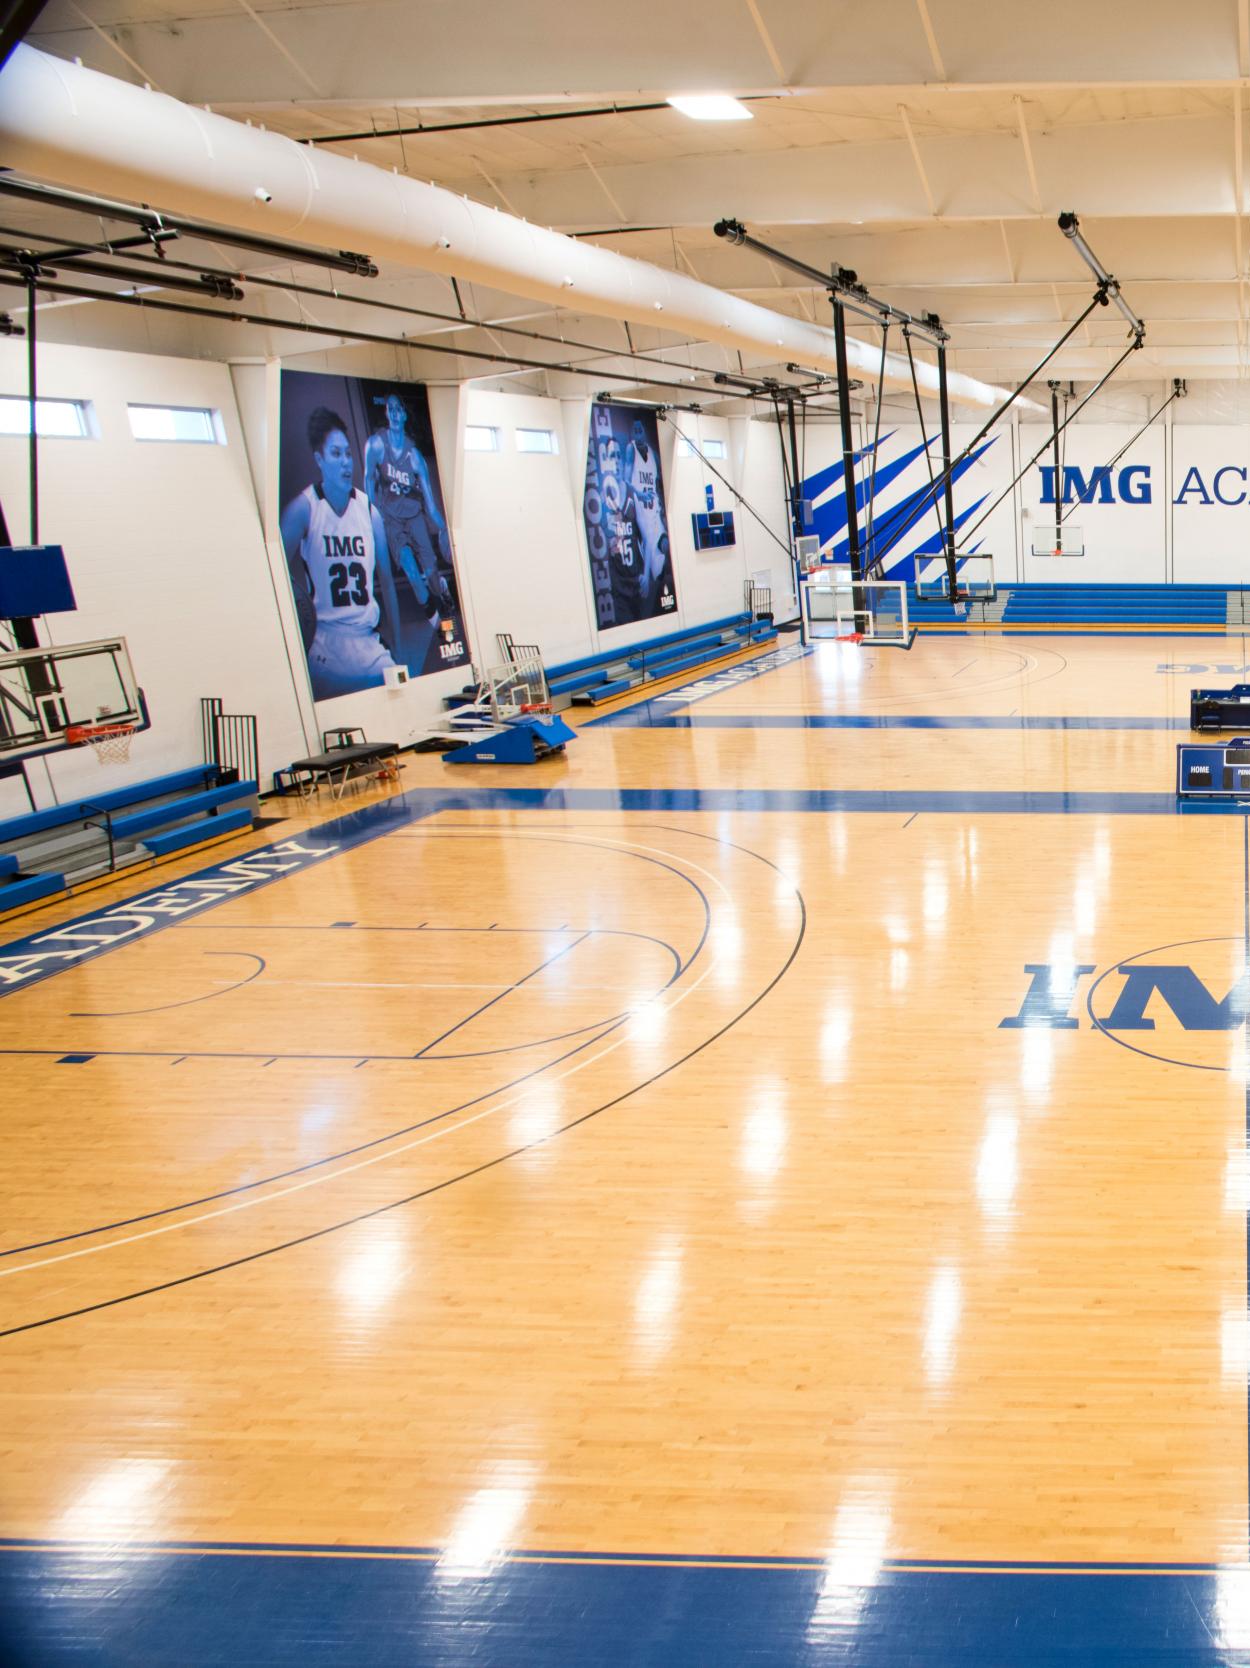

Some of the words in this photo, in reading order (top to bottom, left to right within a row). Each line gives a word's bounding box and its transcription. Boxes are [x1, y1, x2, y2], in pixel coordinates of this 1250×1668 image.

[1039, 465, 1152, 504] IMG
[323, 535, 365, 557] IMG
[328, 562, 370, 607] 23
[661, 595, 675, 608] IMG
[440, 642, 464, 659] IMG
[1191, 766, 1210, 774] HOME
